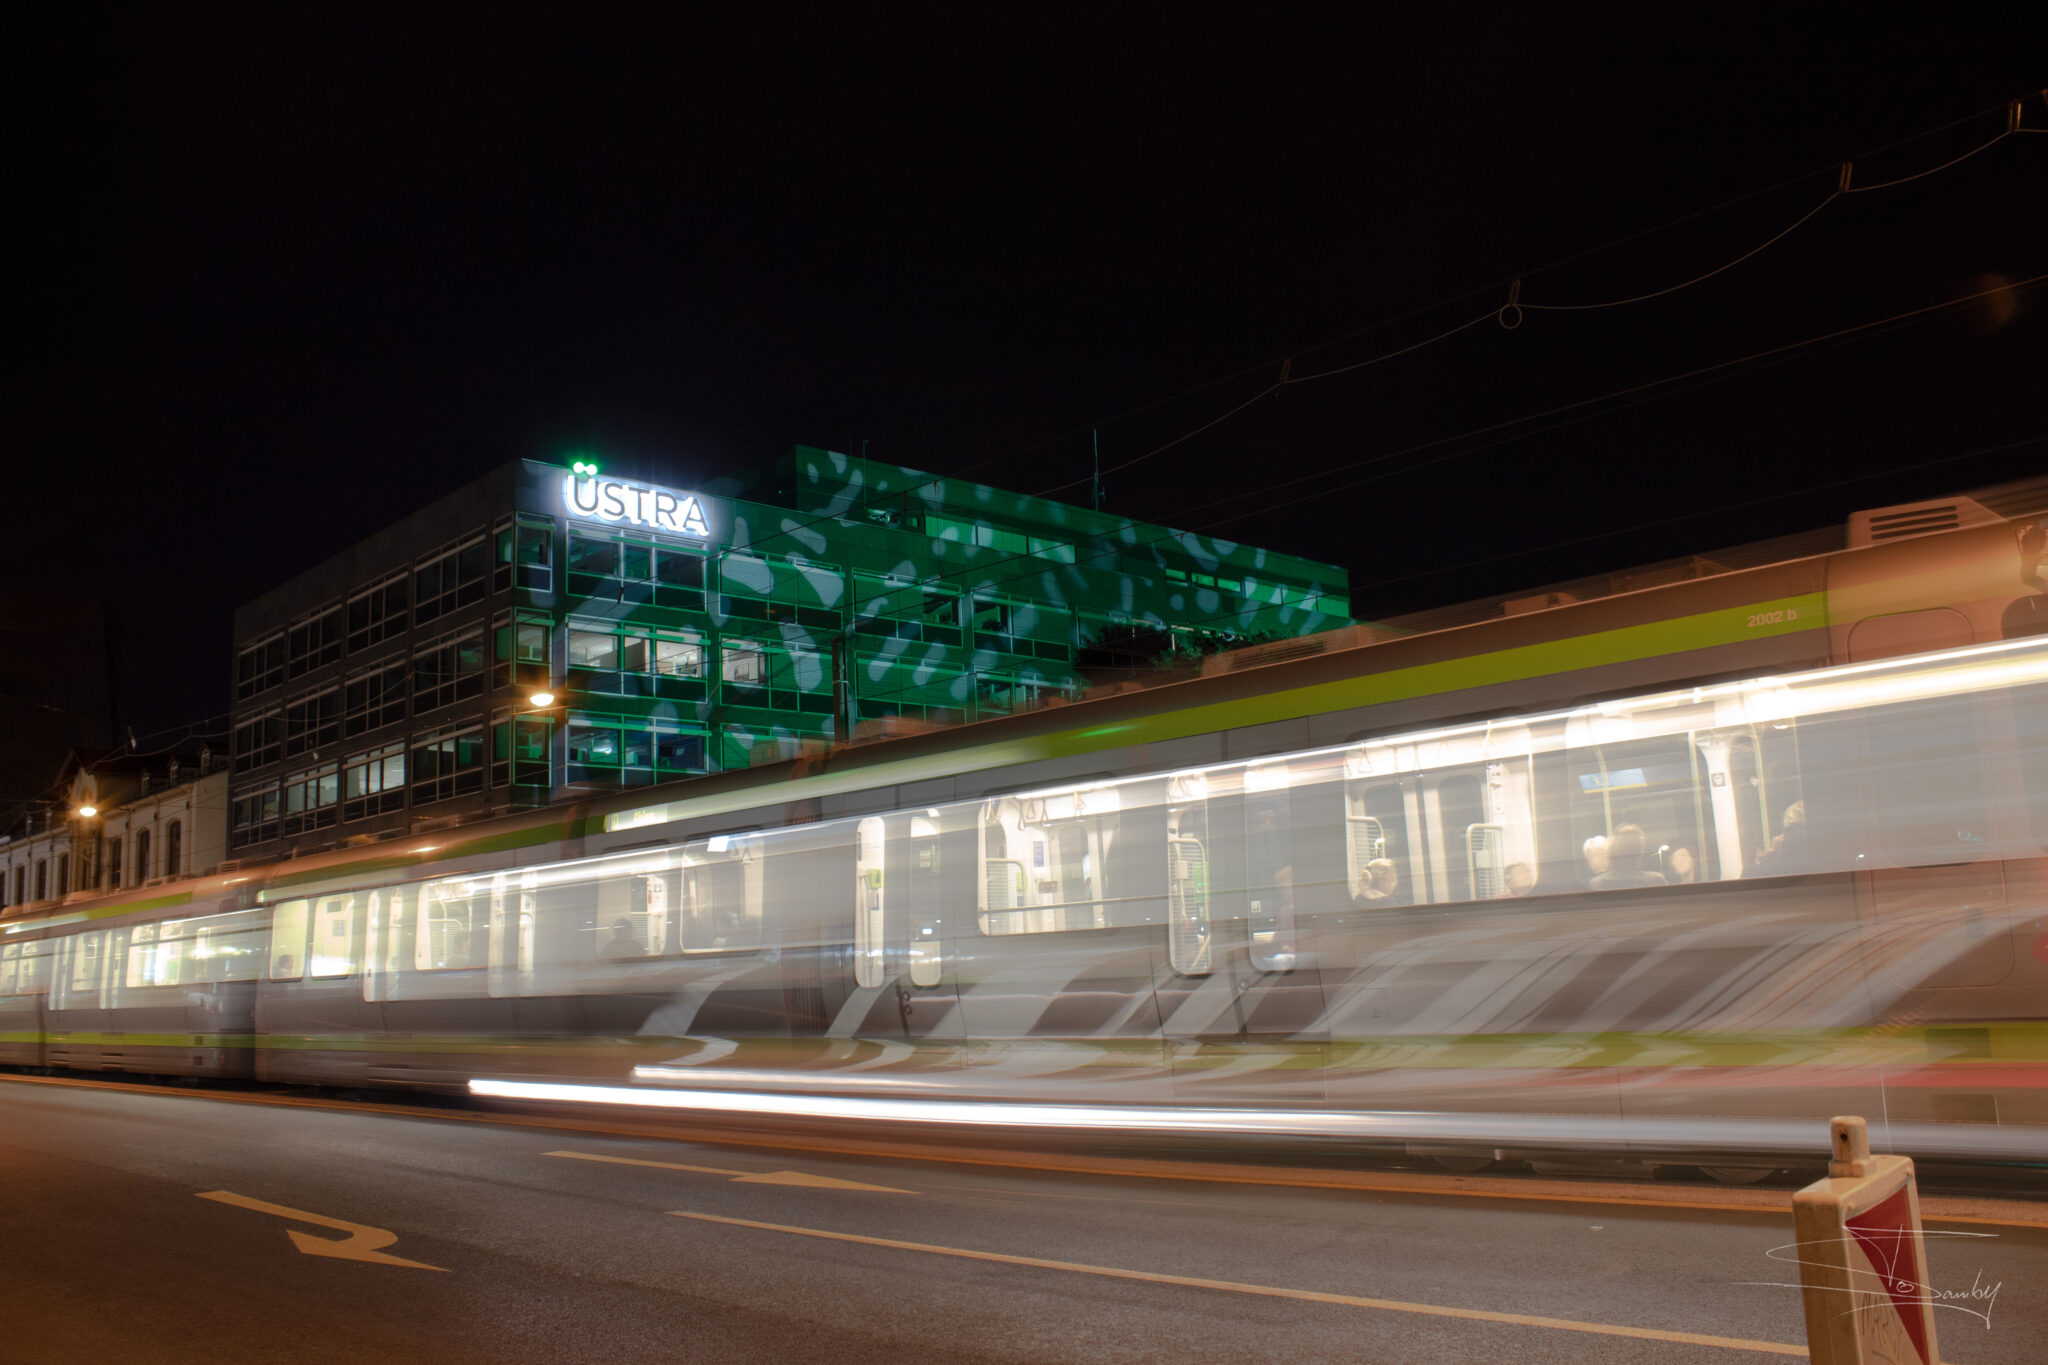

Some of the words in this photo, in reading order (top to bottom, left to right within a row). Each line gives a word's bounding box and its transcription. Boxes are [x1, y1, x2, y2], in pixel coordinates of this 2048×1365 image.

[566, 461, 710, 537] ÜSTRA
[1748, 610, 1783, 628] 2002
[1787, 608, 1798, 621] b
